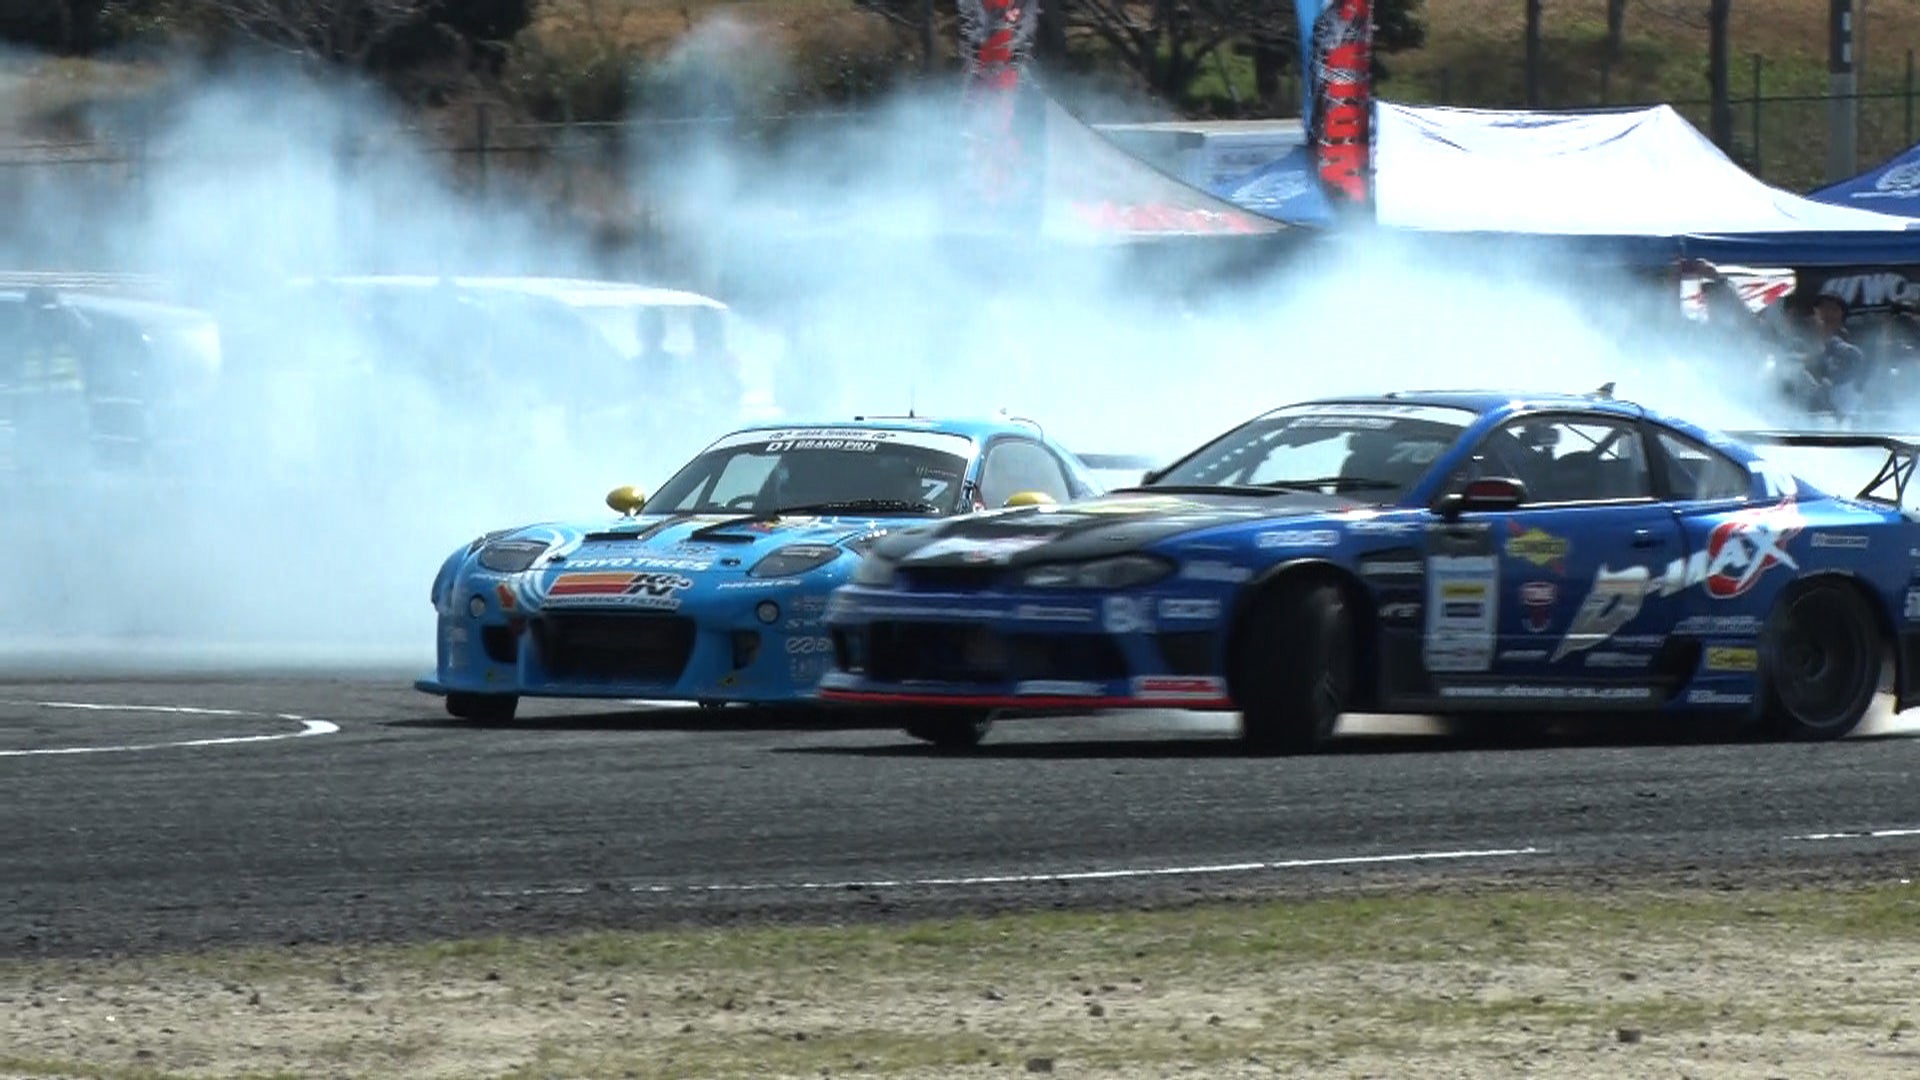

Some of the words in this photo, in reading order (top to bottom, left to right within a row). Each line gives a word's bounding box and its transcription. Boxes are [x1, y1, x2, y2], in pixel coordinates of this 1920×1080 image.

[765, 440, 796, 451] D1
[794, 439, 844, 450] GRAND
[843, 441, 880, 452] PRIX
[921, 478, 949, 501] 7
[563, 557, 633, 569] TOYO
[634, 557, 714, 572] TIRES
